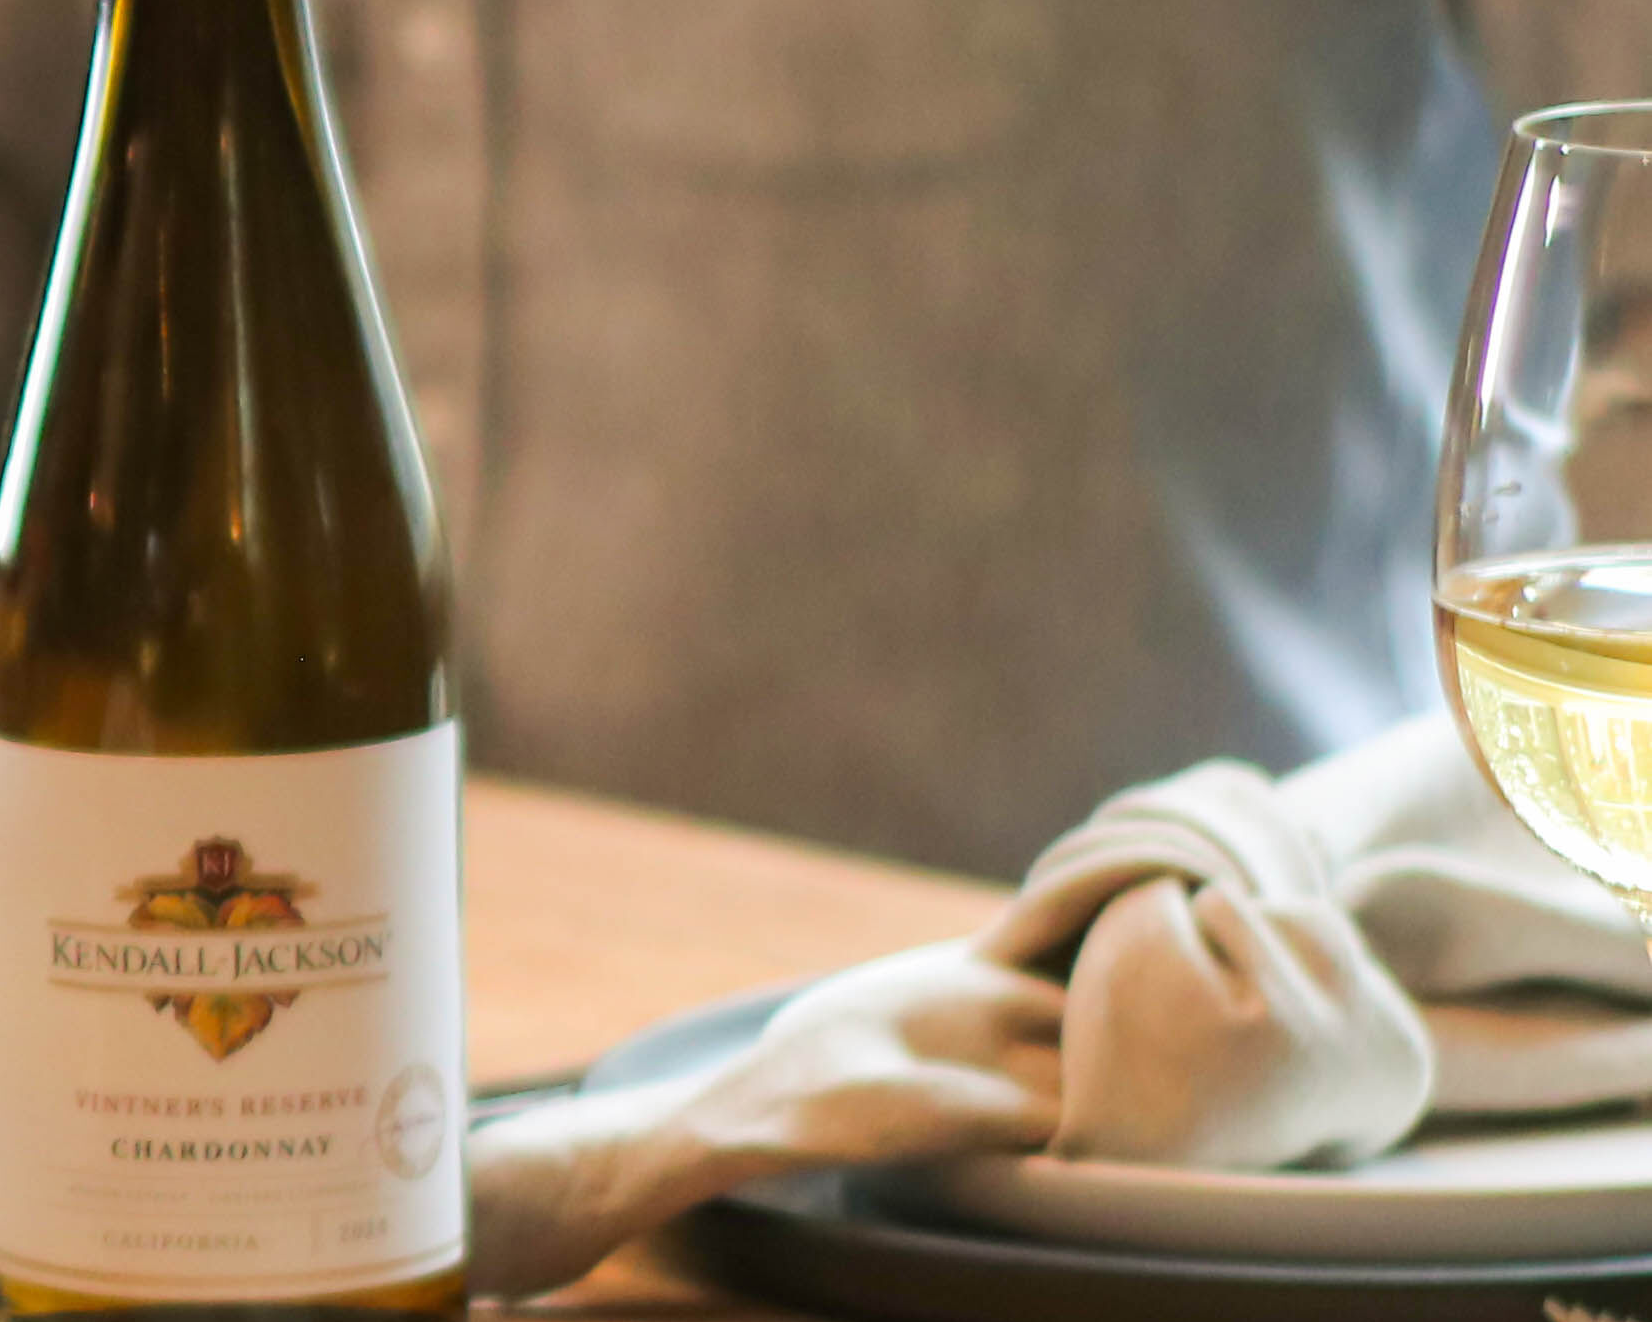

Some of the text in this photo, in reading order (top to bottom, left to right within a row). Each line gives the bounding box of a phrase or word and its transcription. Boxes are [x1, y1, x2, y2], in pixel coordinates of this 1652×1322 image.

[74, 1082, 369, 1117] VINTNER'S RESERVE
[109, 1132, 335, 1162] CHARDONNAY
[102, 1228, 260, 1251] CALIFORNIA
